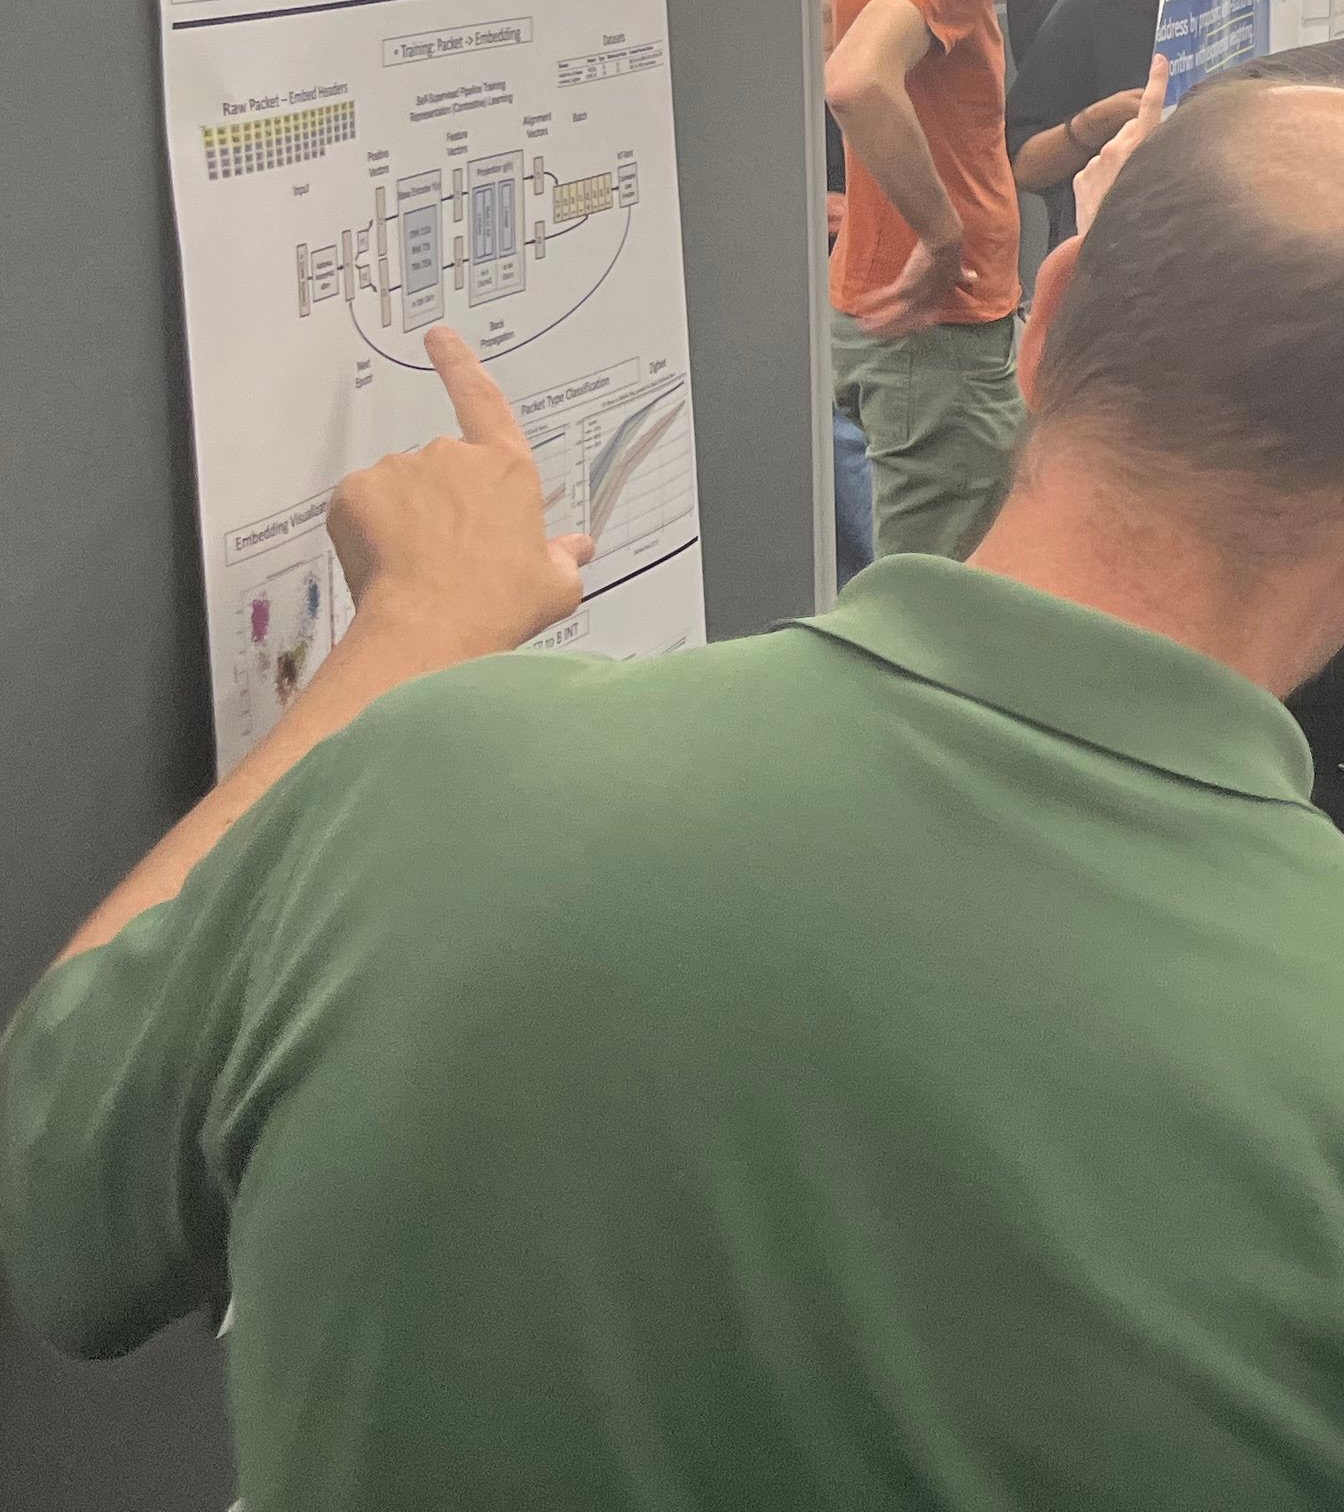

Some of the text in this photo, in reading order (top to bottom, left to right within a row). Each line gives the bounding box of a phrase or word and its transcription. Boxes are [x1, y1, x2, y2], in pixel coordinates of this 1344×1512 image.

[437, 36, 464, 52] Packet
[475, 27, 522, 46] Embedding
[222, 102, 248, 117] Raw
[249, 95, 280, 111] Packet
[288, 88, 316, 105] Embed
[520, 399, 546, 417] Packet
[235, 520, 289, 551] Embedding
